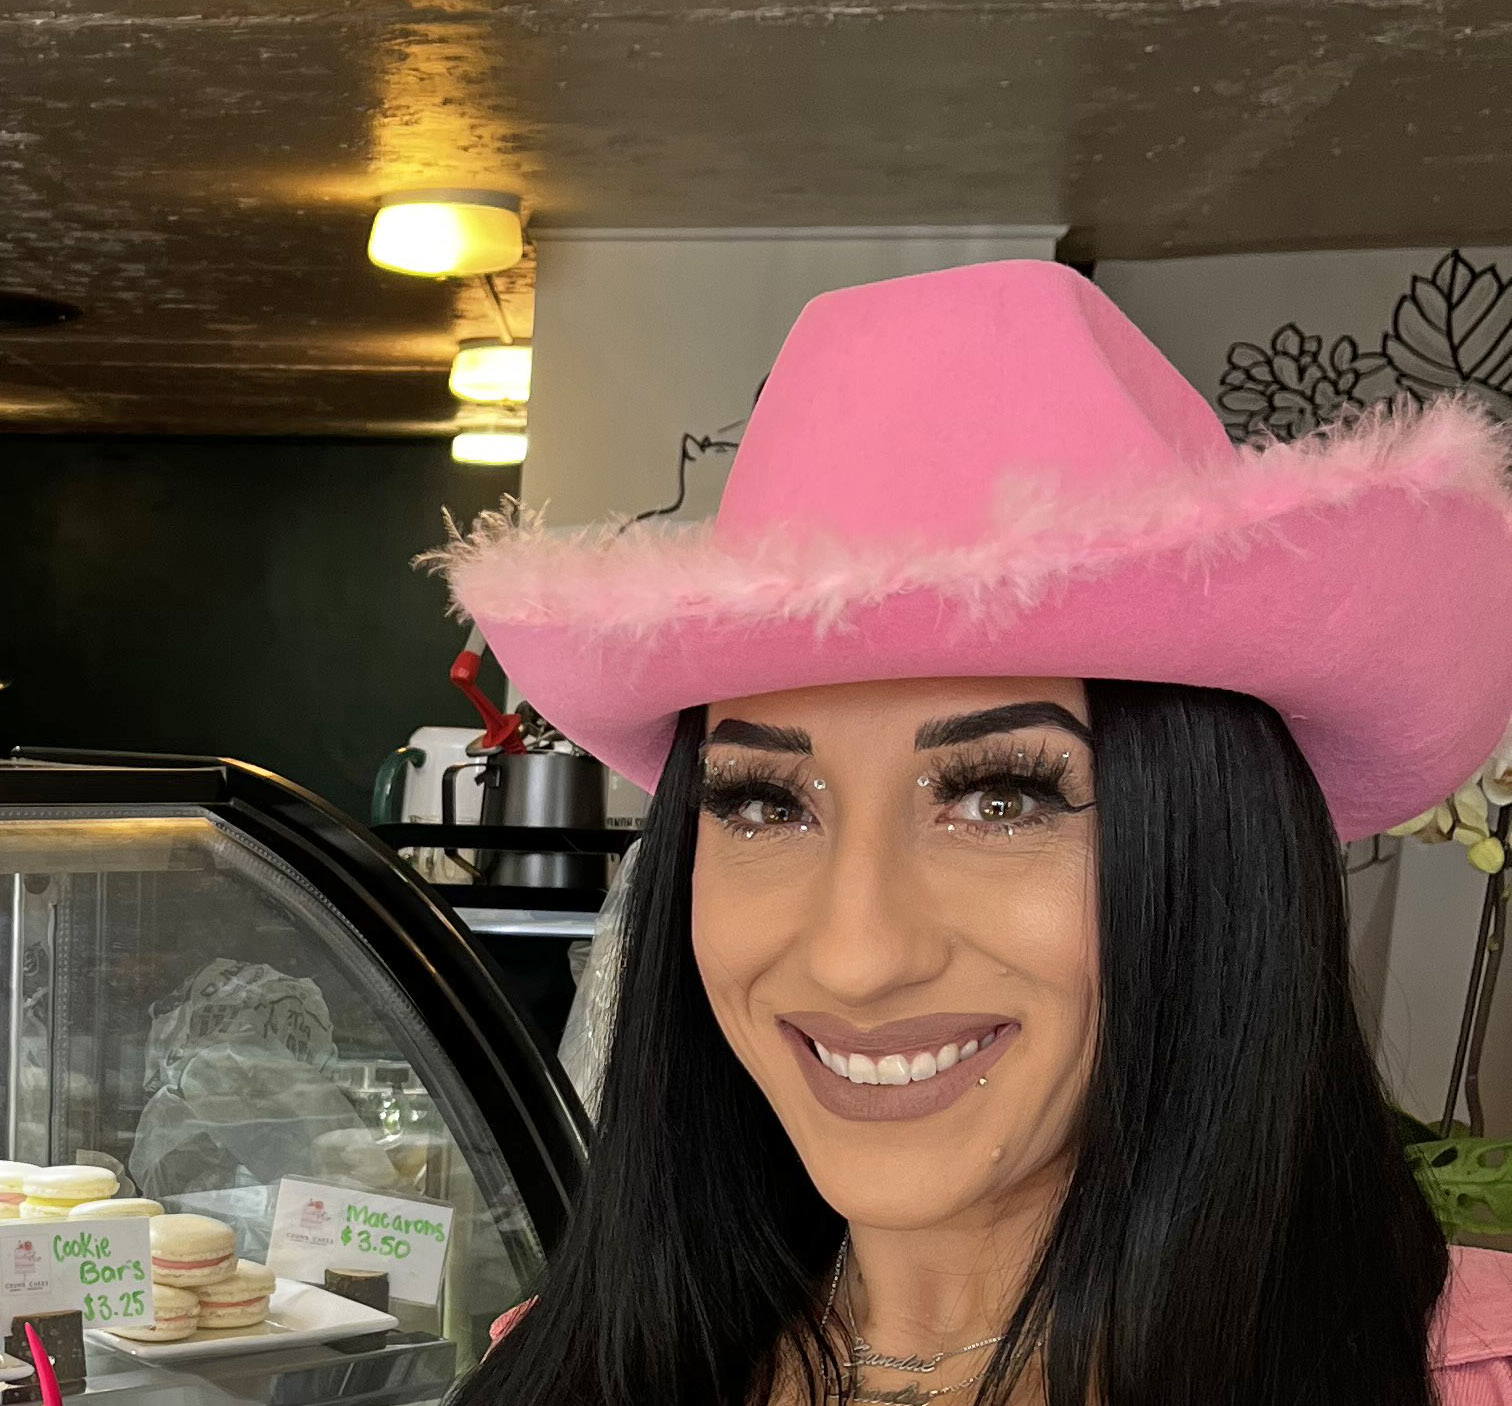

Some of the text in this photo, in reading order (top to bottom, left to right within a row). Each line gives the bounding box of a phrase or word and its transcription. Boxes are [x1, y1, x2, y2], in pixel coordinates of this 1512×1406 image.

[346, 1204, 445, 1242] Macarons
[53, 1231, 112, 1263] Cookie
[341, 1225, 411, 1259] $3.50
[82, 1290, 146, 1321] $3.25
